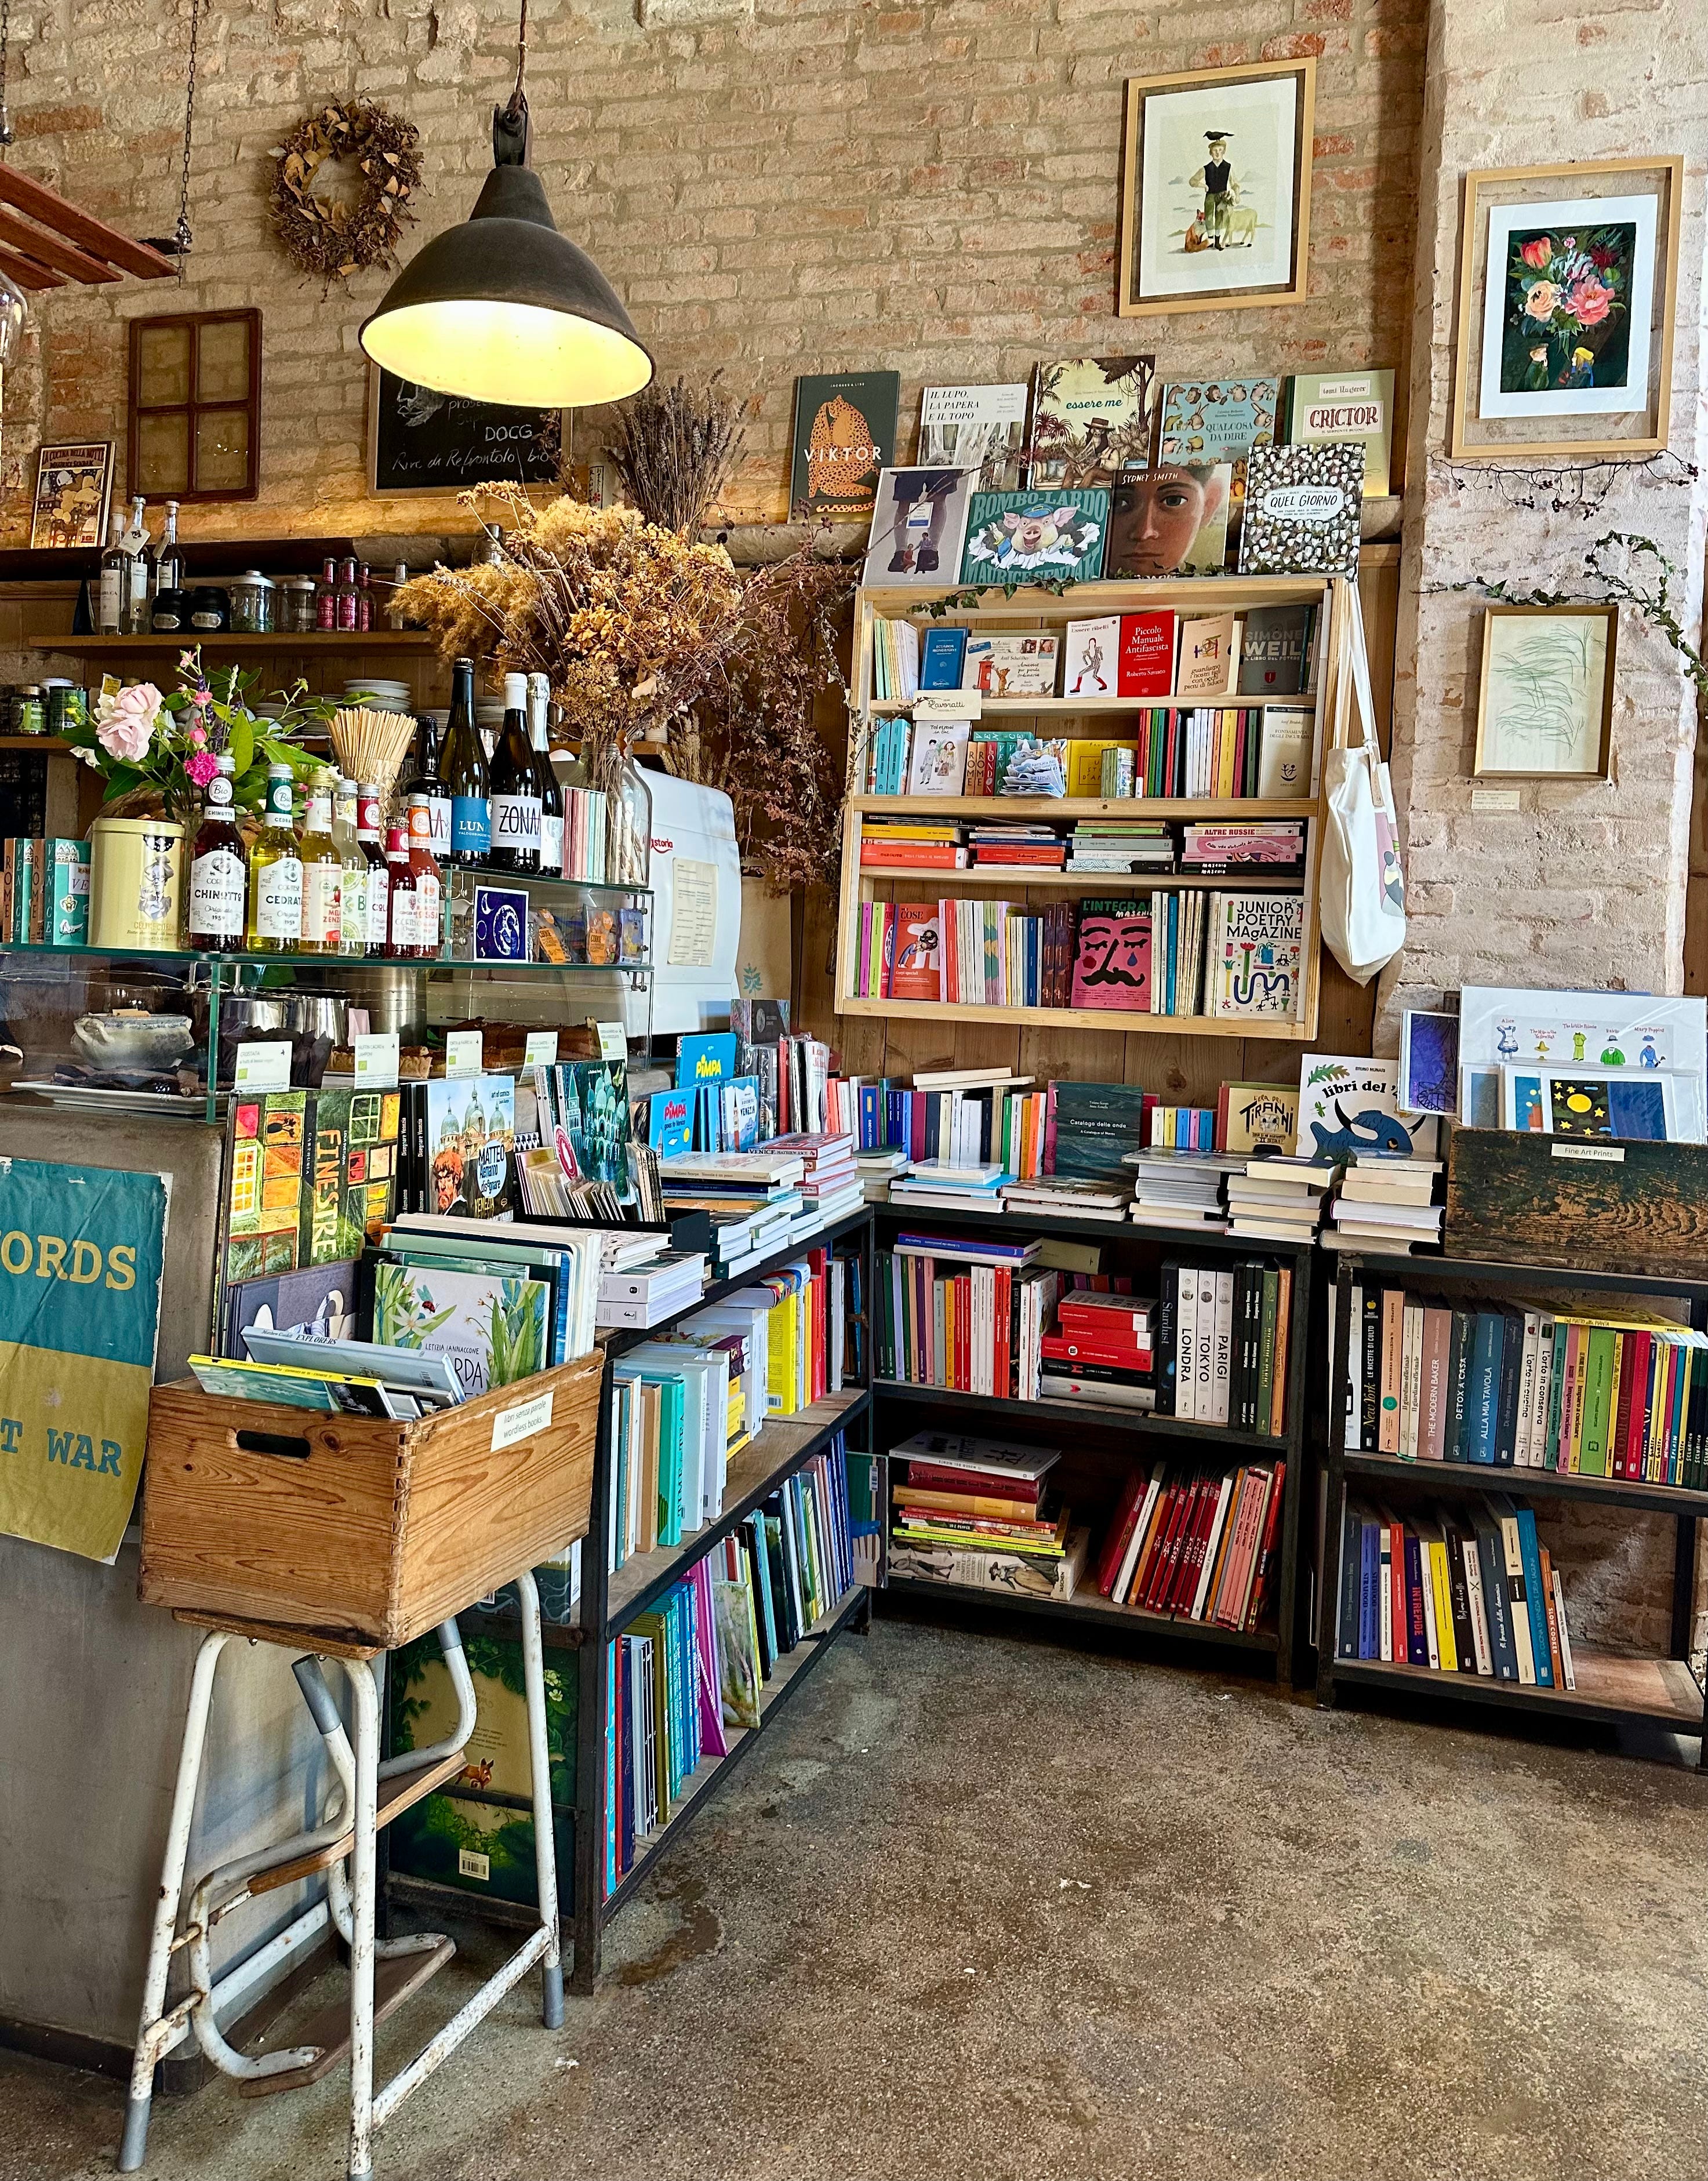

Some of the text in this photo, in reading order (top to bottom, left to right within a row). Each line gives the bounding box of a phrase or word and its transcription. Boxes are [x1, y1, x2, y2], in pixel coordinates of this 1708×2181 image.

[942, 390, 969, 399] LUPO,
[944, 401, 980, 409] PAPERA
[1066, 398, 1124, 409] essere me
[928, 411, 975, 420] E IL TOPO
[1205, 422, 1253, 432] QUALCOSA
[1309, 406, 1379, 430] CRICTOR
[485, 424, 533, 442] DOCG
[1209, 432, 1248, 442] DA DIRE
[804, 446, 882, 463] VIKTOR
[1122, 472, 1179, 485] SYDNEY SMITH
[973, 490, 1107, 523] BOMBO-LARDO
[1270, 495, 1338, 508] QUEL GIORNO
[1131, 635, 1164, 645] Manuale
[1135, 625, 1162, 636] Piccolo
[1245, 630, 1304, 641] SIMONE
[1125, 643, 1169, 654] Antifascista
[1244, 640, 1302, 656] WEIL
[967, 751, 975, 787] ROME
[976, 751, 985, 787] ROME
[986, 744, 996, 794] LONDON
[213, 784, 228, 795] Bio
[3, 855, 12, 918] ROME
[14, 844, 23, 933] VENICE
[31, 855, 39, 918] ROME
[45, 843, 54, 933] VENICE
[900, 911, 924, 921] COSE
[1237, 900, 1294, 915] JUNIOR
[1237, 914, 1294, 926] POETRY
[1226, 925, 1302, 941] MAgAZINE
[1322, 1080, 1387, 1099] libri del
[1070, 1119, 1096, 1127] Catalogo
[478, 1143, 505, 1166] MATTEO
[1564, 1147, 1614, 1158] Fine Art Prints
[311, 1129, 341, 1258] FINESTRE
[474, 1197, 495, 1213] VENEZIA
[0, 1228, 137, 1291] ORDS
[1161, 1302, 1173, 1345] Stardust
[295, 1333, 338, 1347] EXPLORERS
[425, 1343, 479, 1355] LETIZIA IANNACCONE
[1180, 1328, 1193, 1383] LONDRA
[1199, 1335, 1211, 1383] TOKYO
[1216, 1335, 1229, 1380] PARIGI
[1525, 1354, 1535, 1377] L'orto
[1458, 1357, 1467, 1380] CASA
[1363, 1382, 1376, 1405] York
[1427, 1358, 1439, 1437] THE MODERN BAKER
[1536, 1350, 1551, 1425] L'orto in conserva
[1564, 1386, 1573, 1408] Imparo
[1575, 1384, 1583, 1407] Imparo
[504, 1400, 546, 1424] libri senza parole
[1456, 1390, 1465, 1420] DETOX
[1480, 1367, 1492, 1440] ALLA MIA TAVOLA
[503, 1417, 543, 1438] wordless books.
[1363, 1404, 1376, 1430] New
[46, 1428, 122, 1477] WAR
[1170, 1537, 1181, 1564] KIMONO
[1184, 1537, 1194, 1564] KIMONO
[1197, 1540, 1208, 1568] KIMONO
[1412, 1586, 1423, 1636] INTREPIDE
[1547, 1608, 1558, 1655] SLOW COOKER
